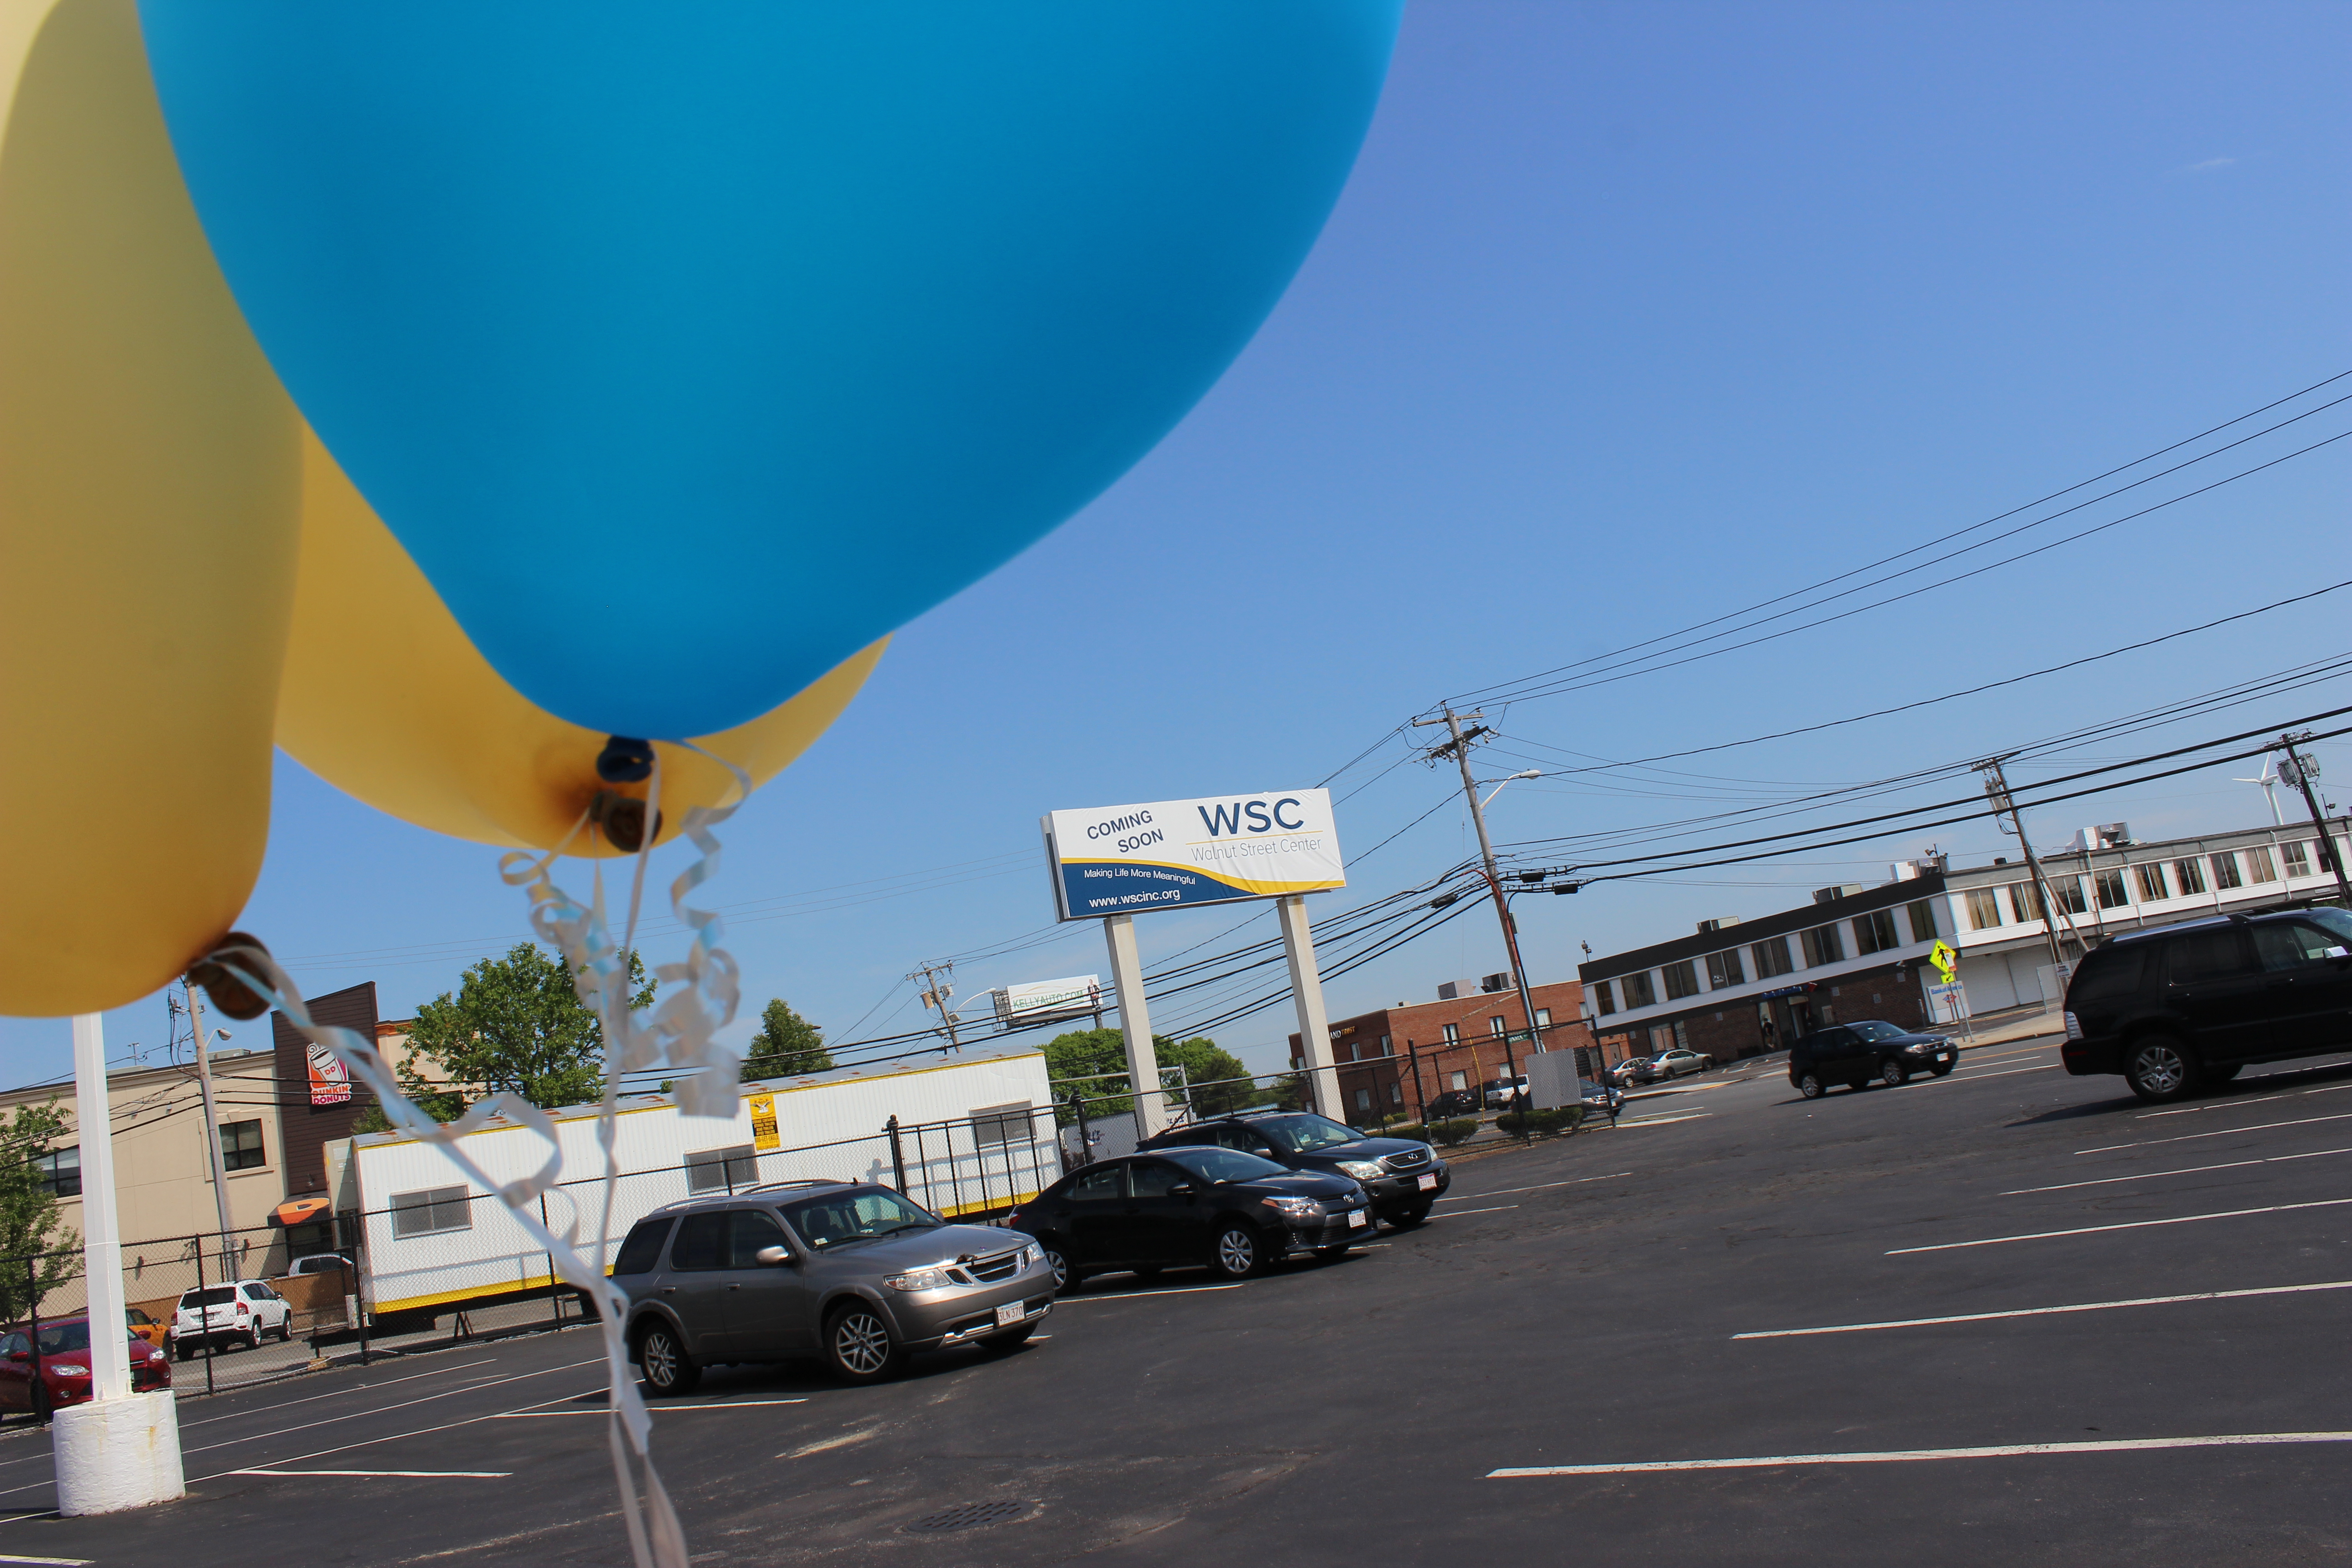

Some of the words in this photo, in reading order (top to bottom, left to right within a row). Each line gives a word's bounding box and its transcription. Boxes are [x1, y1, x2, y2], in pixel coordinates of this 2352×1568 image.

[1087, 810, 1153, 839] COMING
[1197, 798, 1304, 836] WSC
[1117, 828, 1164, 853] SOON
[1191, 845, 1237, 861] Walnut
[1240, 841, 1278, 857] Street
[1280, 838, 1321, 853] Center
[1084, 869, 1112, 879] Making
[1115, 868, 1129, 877] Life
[1131, 868, 1151, 878] More
[1153, 870, 1196, 885] Meaningful
[1088, 889, 1181, 908] www.wscinc.org
[1013, 990, 1084, 1009] KELLYAUTOCOM
[1341, 1026, 1355, 1035] TRUST
[324, 1066, 336, 1075] DD
[313, 1085, 350, 1097] DUNKIN'
[314, 1093, 349, 1104] DONUTS
[999, 1309, 1010, 1321] 3LN
[1011, 1306, 1023, 1317] 370
